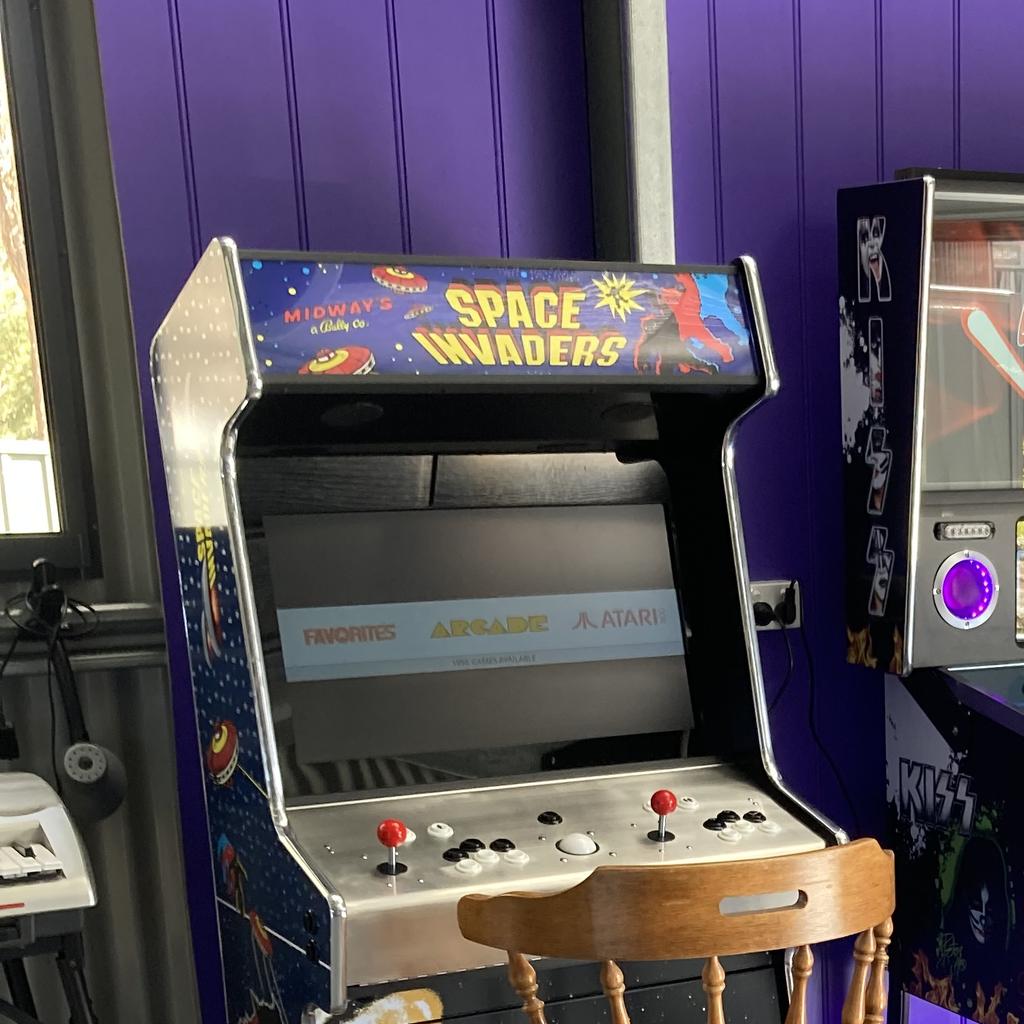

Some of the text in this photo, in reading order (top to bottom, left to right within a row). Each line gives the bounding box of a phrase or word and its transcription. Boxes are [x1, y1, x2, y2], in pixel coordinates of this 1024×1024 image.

[444, 284, 588, 330] SPACE
[411, 328, 628, 368] INVADERS
[857, 216, 896, 617] KISS
[303, 624, 396, 646] FAVORITES
[430, 615, 549, 638] ARCADE
[602, 607, 659, 630] ATARI
[899, 757, 977, 838] KISS
